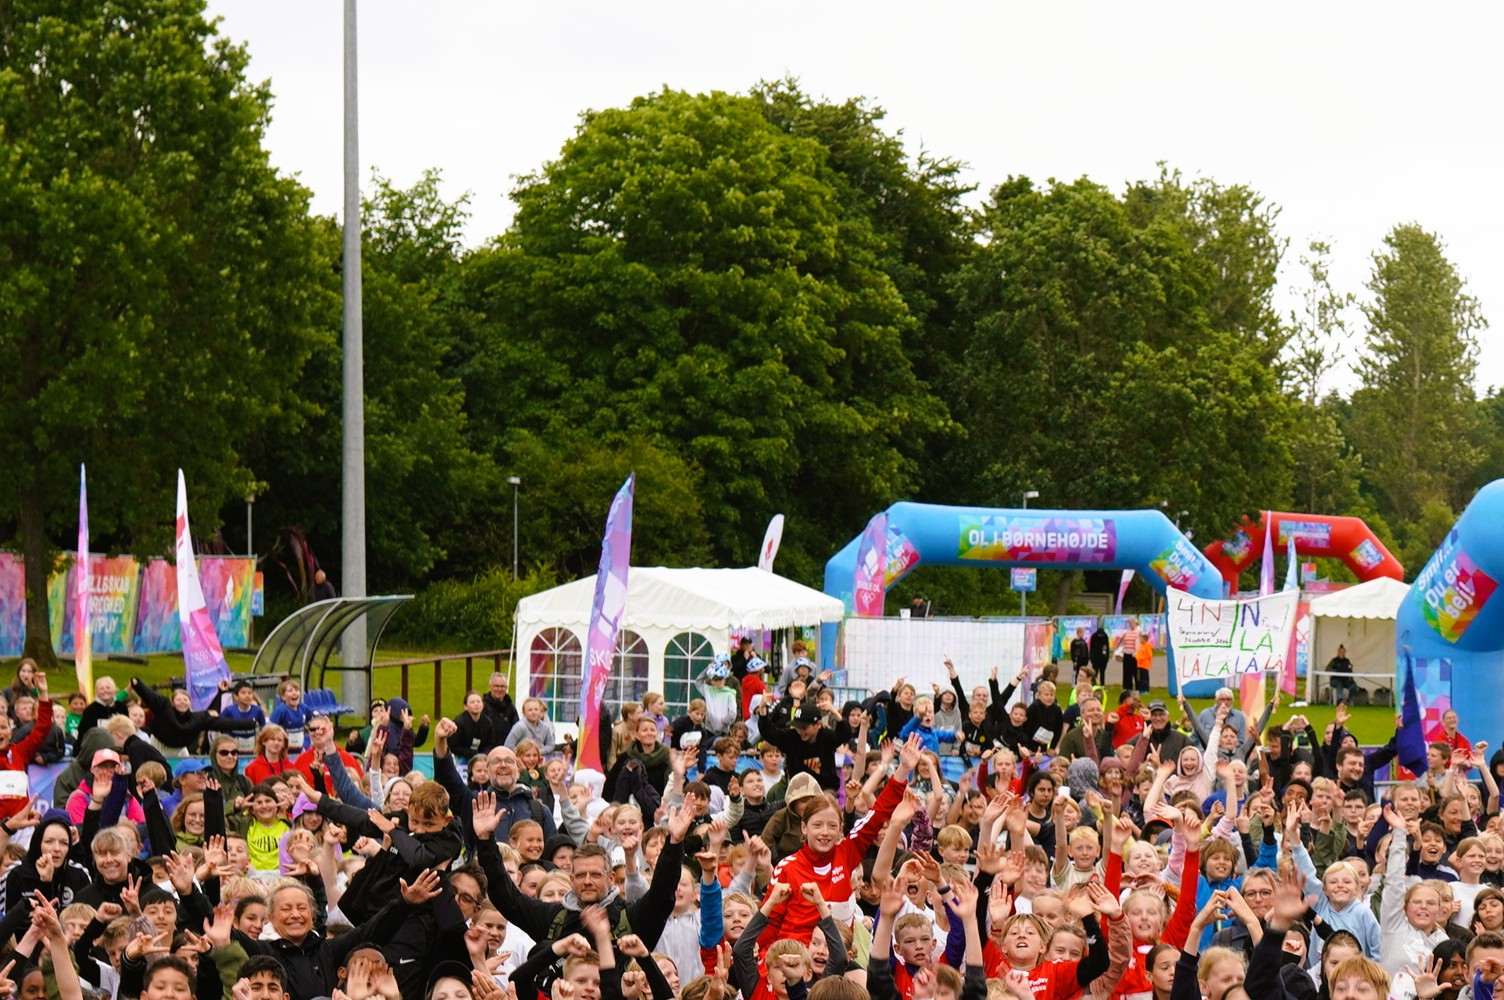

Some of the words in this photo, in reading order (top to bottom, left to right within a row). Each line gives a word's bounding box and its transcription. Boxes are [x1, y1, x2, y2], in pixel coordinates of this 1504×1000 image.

[968, 530, 993, 546] OL
[995, 531, 1000, 546] I
[1002, 530, 1108, 550] BØRNEHØJDE
[1169, 552, 1183, 568] Du
[1181, 565, 1193, 579] er
[1418, 542, 1457, 593] Smil...
[1425, 582, 1447, 610] Du
[1444, 560, 1462, 586] er
[1446, 583, 1475, 619] sej!
